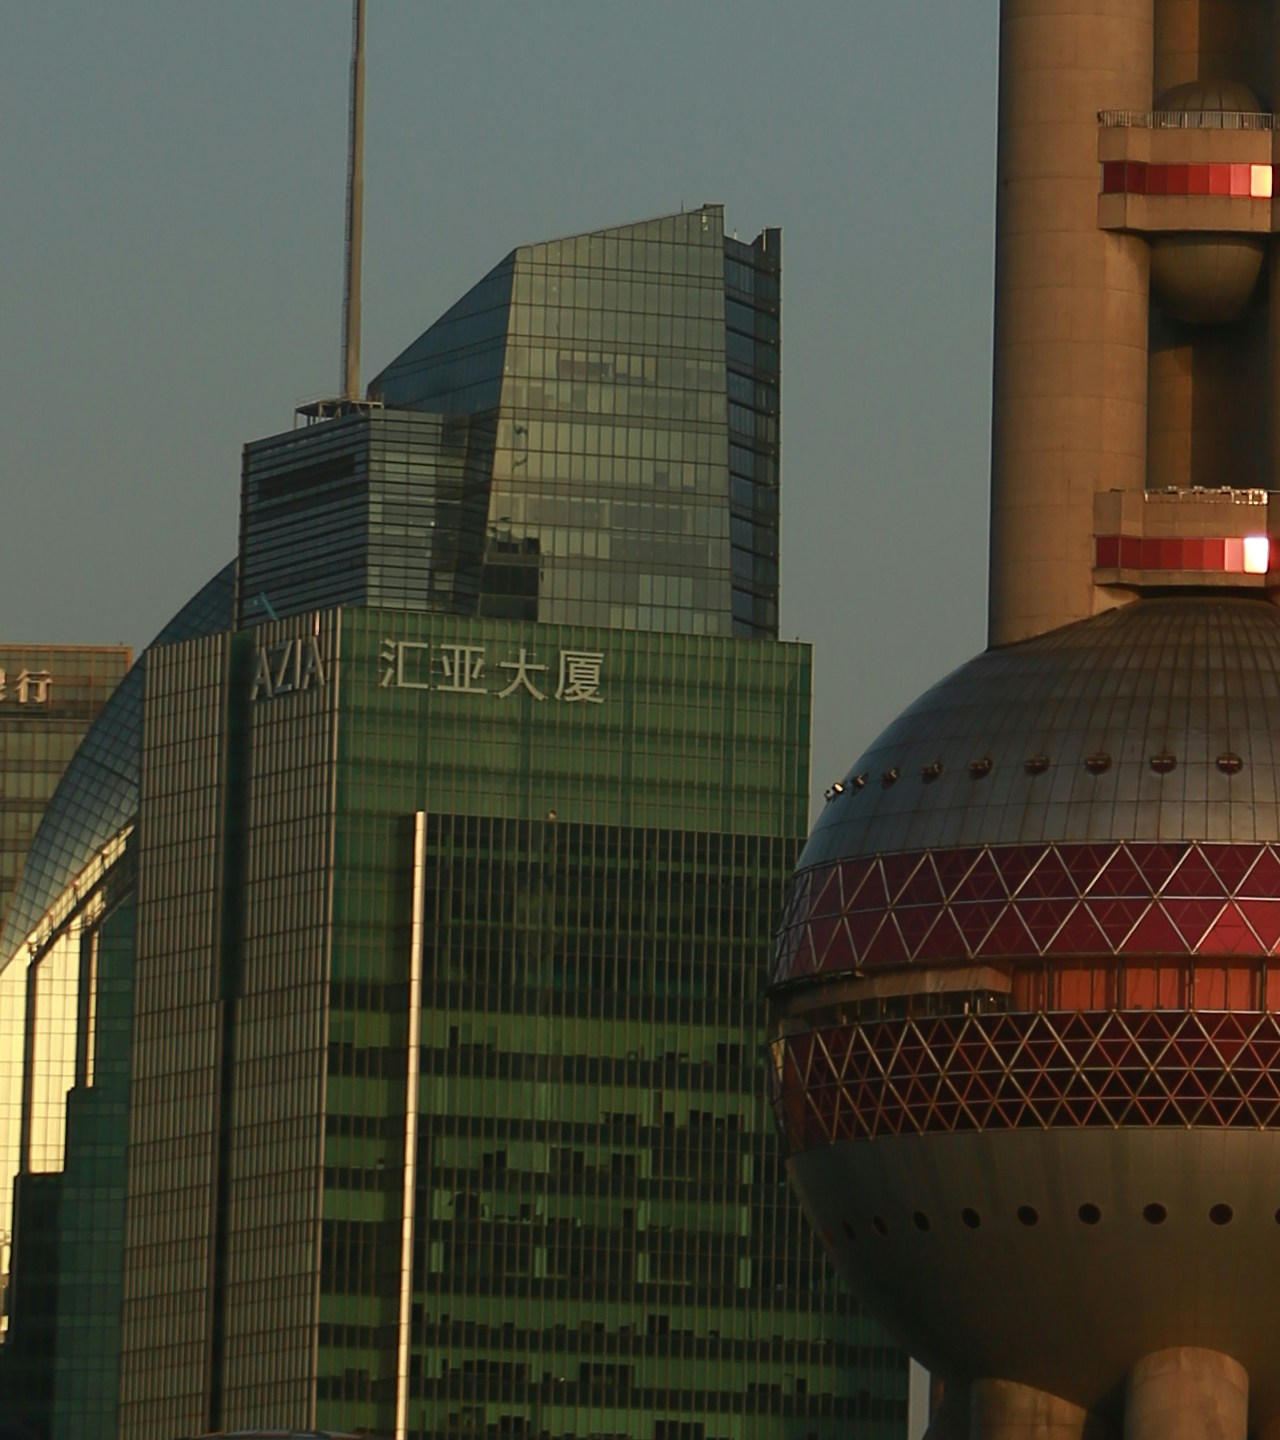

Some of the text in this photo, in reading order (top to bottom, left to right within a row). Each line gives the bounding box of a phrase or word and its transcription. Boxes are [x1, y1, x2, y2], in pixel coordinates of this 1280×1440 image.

[0, 667, 53, 703] 行
[250, 635, 325, 700] AZIA
[379, 638, 605, 704] 汇亚大厦
